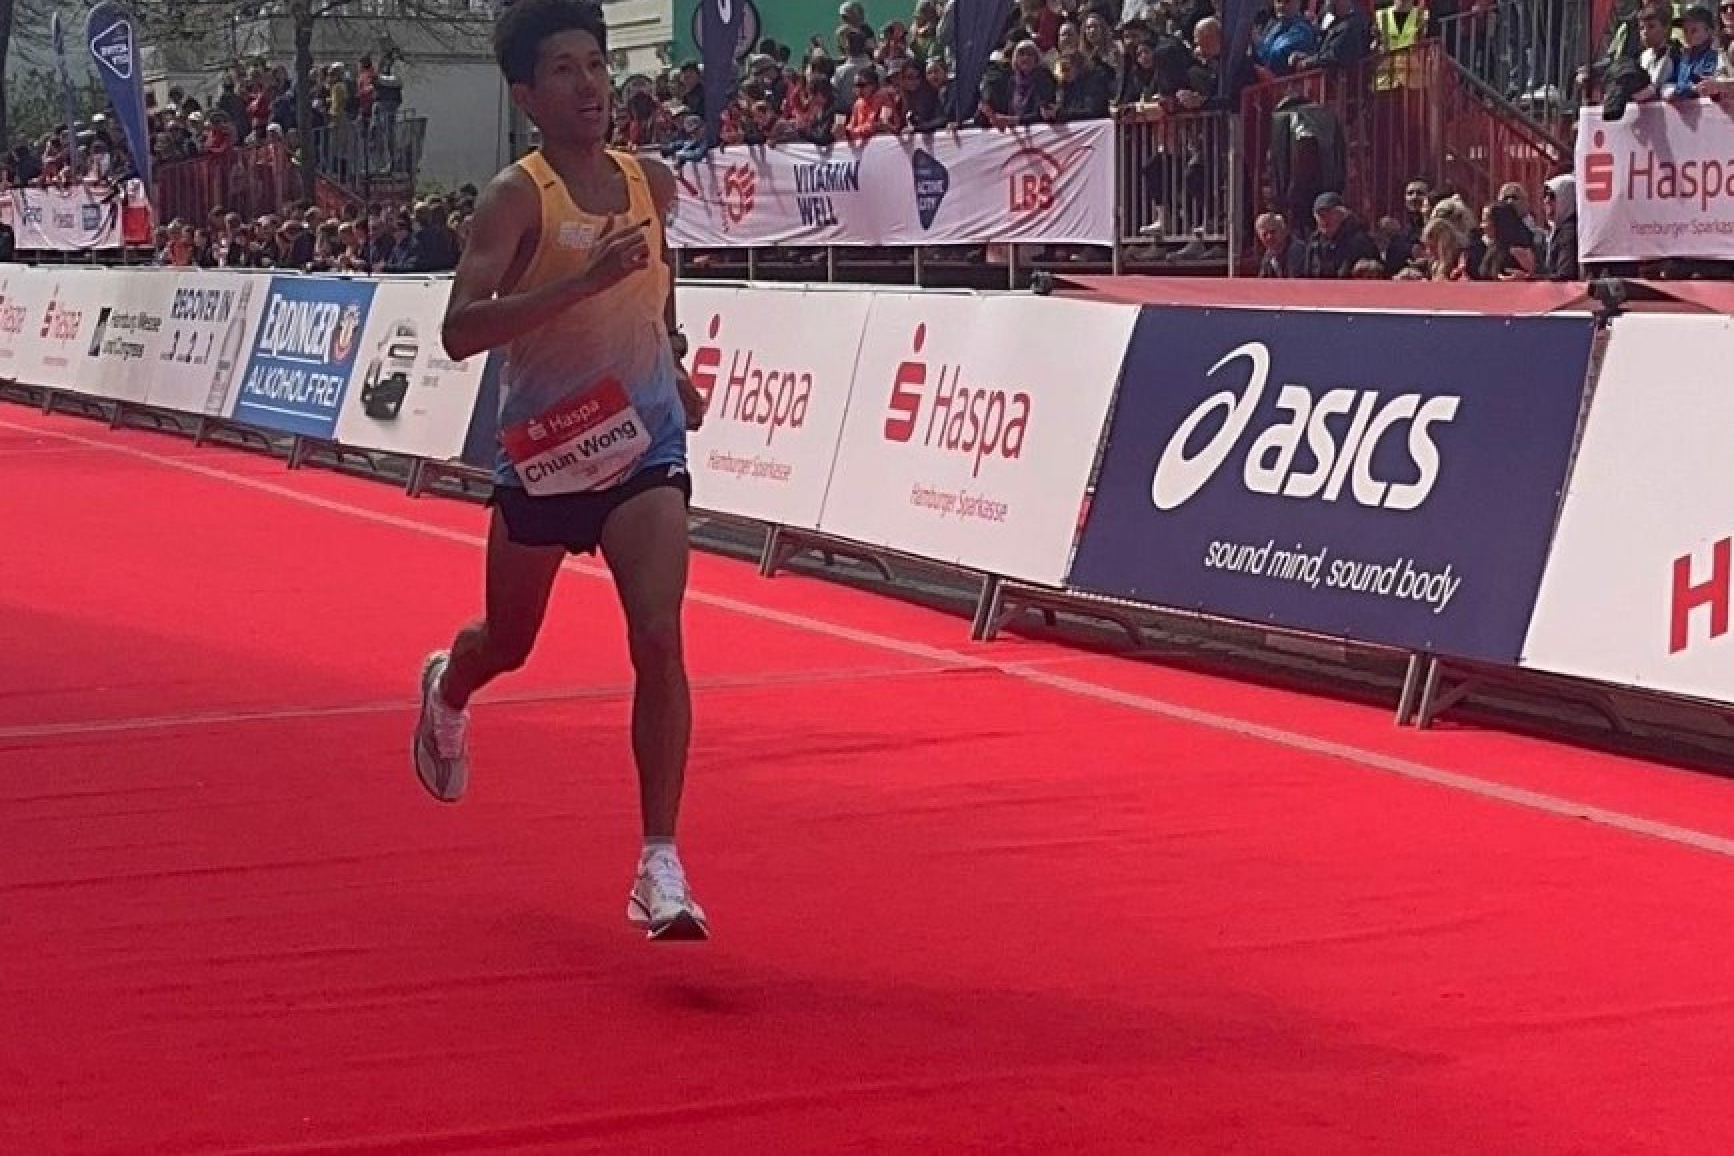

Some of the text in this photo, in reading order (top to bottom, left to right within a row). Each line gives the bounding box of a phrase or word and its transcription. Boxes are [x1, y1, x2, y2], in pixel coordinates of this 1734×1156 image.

[793, 159, 861, 193] VITAMIN
[1009, 172, 1054, 213] LBS
[795, 195, 839, 228] WELL
[259, 293, 341, 365] ERDINGER
[243, 364, 345, 408] ALKOHOLFREI
[719, 348, 813, 447] Haspa
[547, 398, 601, 434] Haspa
[923, 363, 1031, 479] Haspa
[524, 450, 578, 484] Chun
[576, 418, 638, 459] Wong
[1204, 540, 1462, 614] sound mind, sound body
